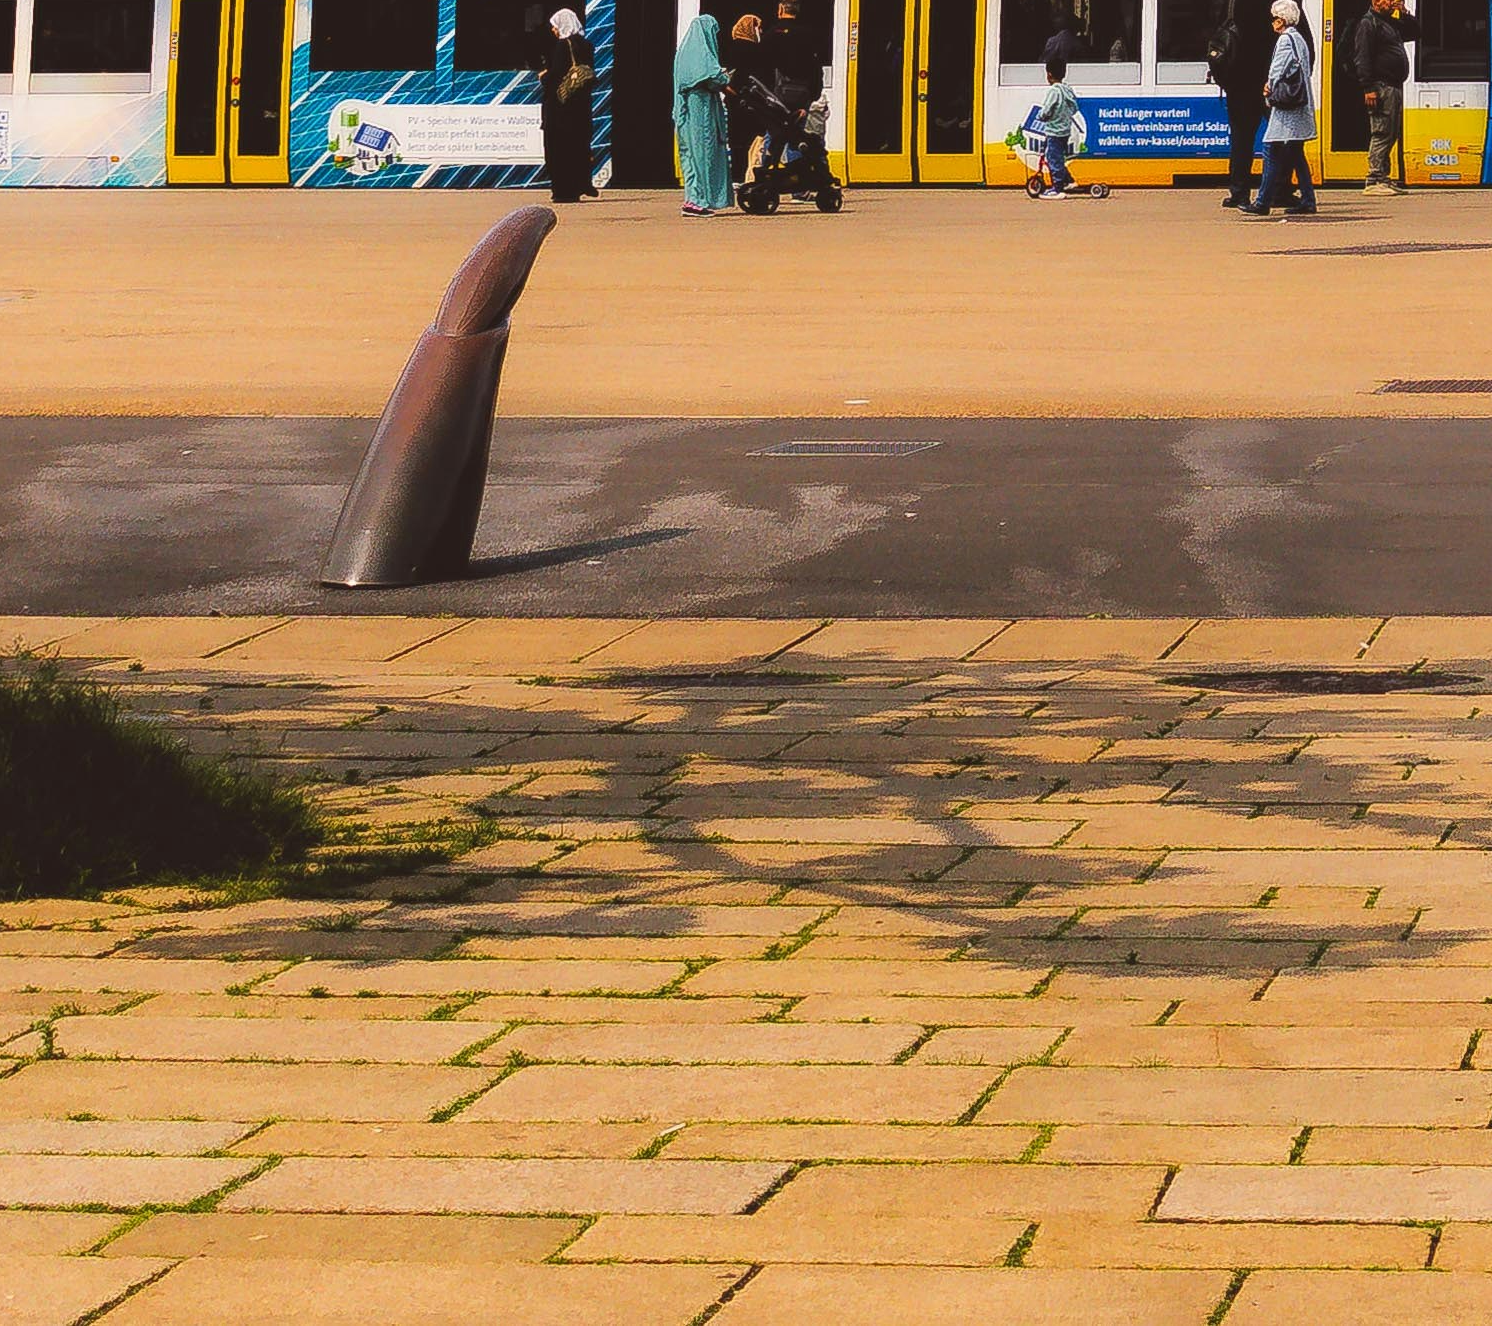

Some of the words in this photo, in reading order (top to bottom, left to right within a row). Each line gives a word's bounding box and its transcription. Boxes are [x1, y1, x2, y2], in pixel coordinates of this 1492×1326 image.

[1098, 108, 1123, 118] Nicht
[1124, 108, 1153, 121] länger
[1154, 108, 1190, 118] warten!
[1098, 122, 1130, 132] Termin
[1131, 121, 1185, 132] vereinbaren
[1186, 122, 1204, 132] und
[1098, 135, 1135, 146] wählen:
[1430, 138, 1452, 151] RBK
[1424, 154, 1459, 167] 634B
